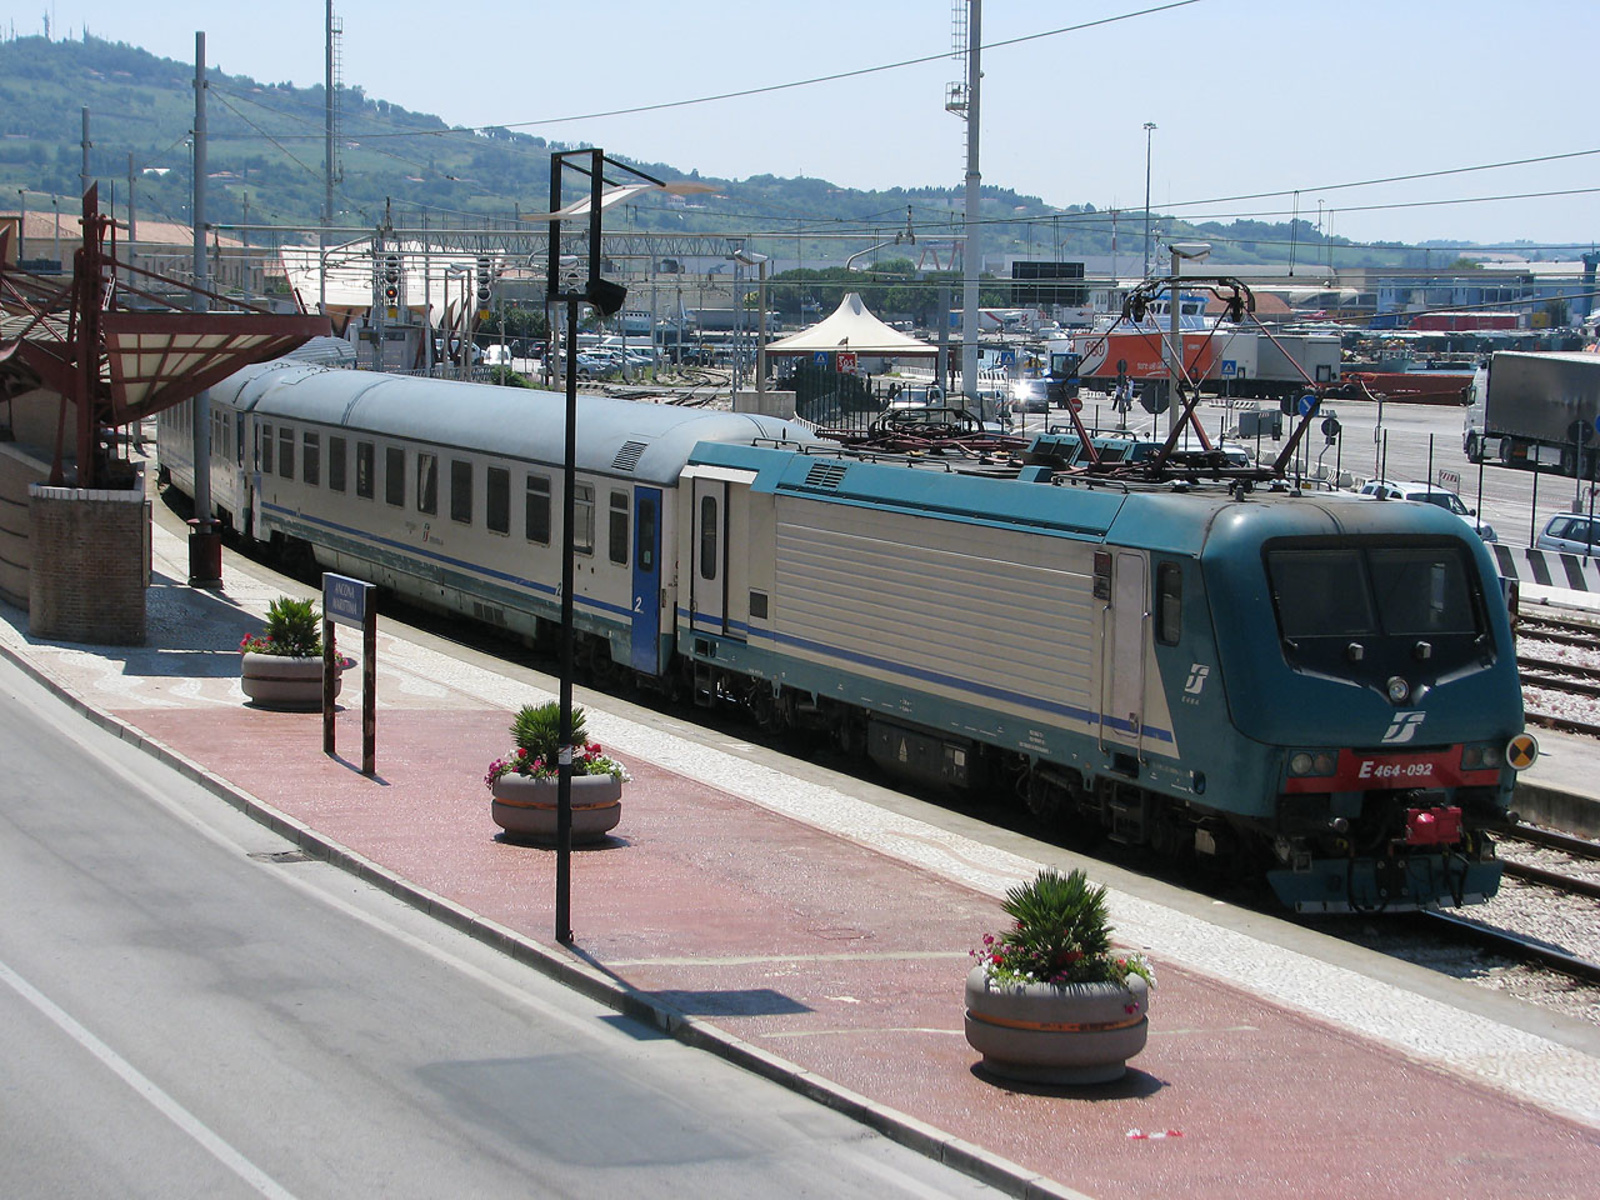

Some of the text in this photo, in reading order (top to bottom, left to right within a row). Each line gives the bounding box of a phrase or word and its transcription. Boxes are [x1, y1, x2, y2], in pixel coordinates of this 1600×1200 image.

[634, 596, 644, 613] 2
[1358, 761, 1433, 778] E 464-092
